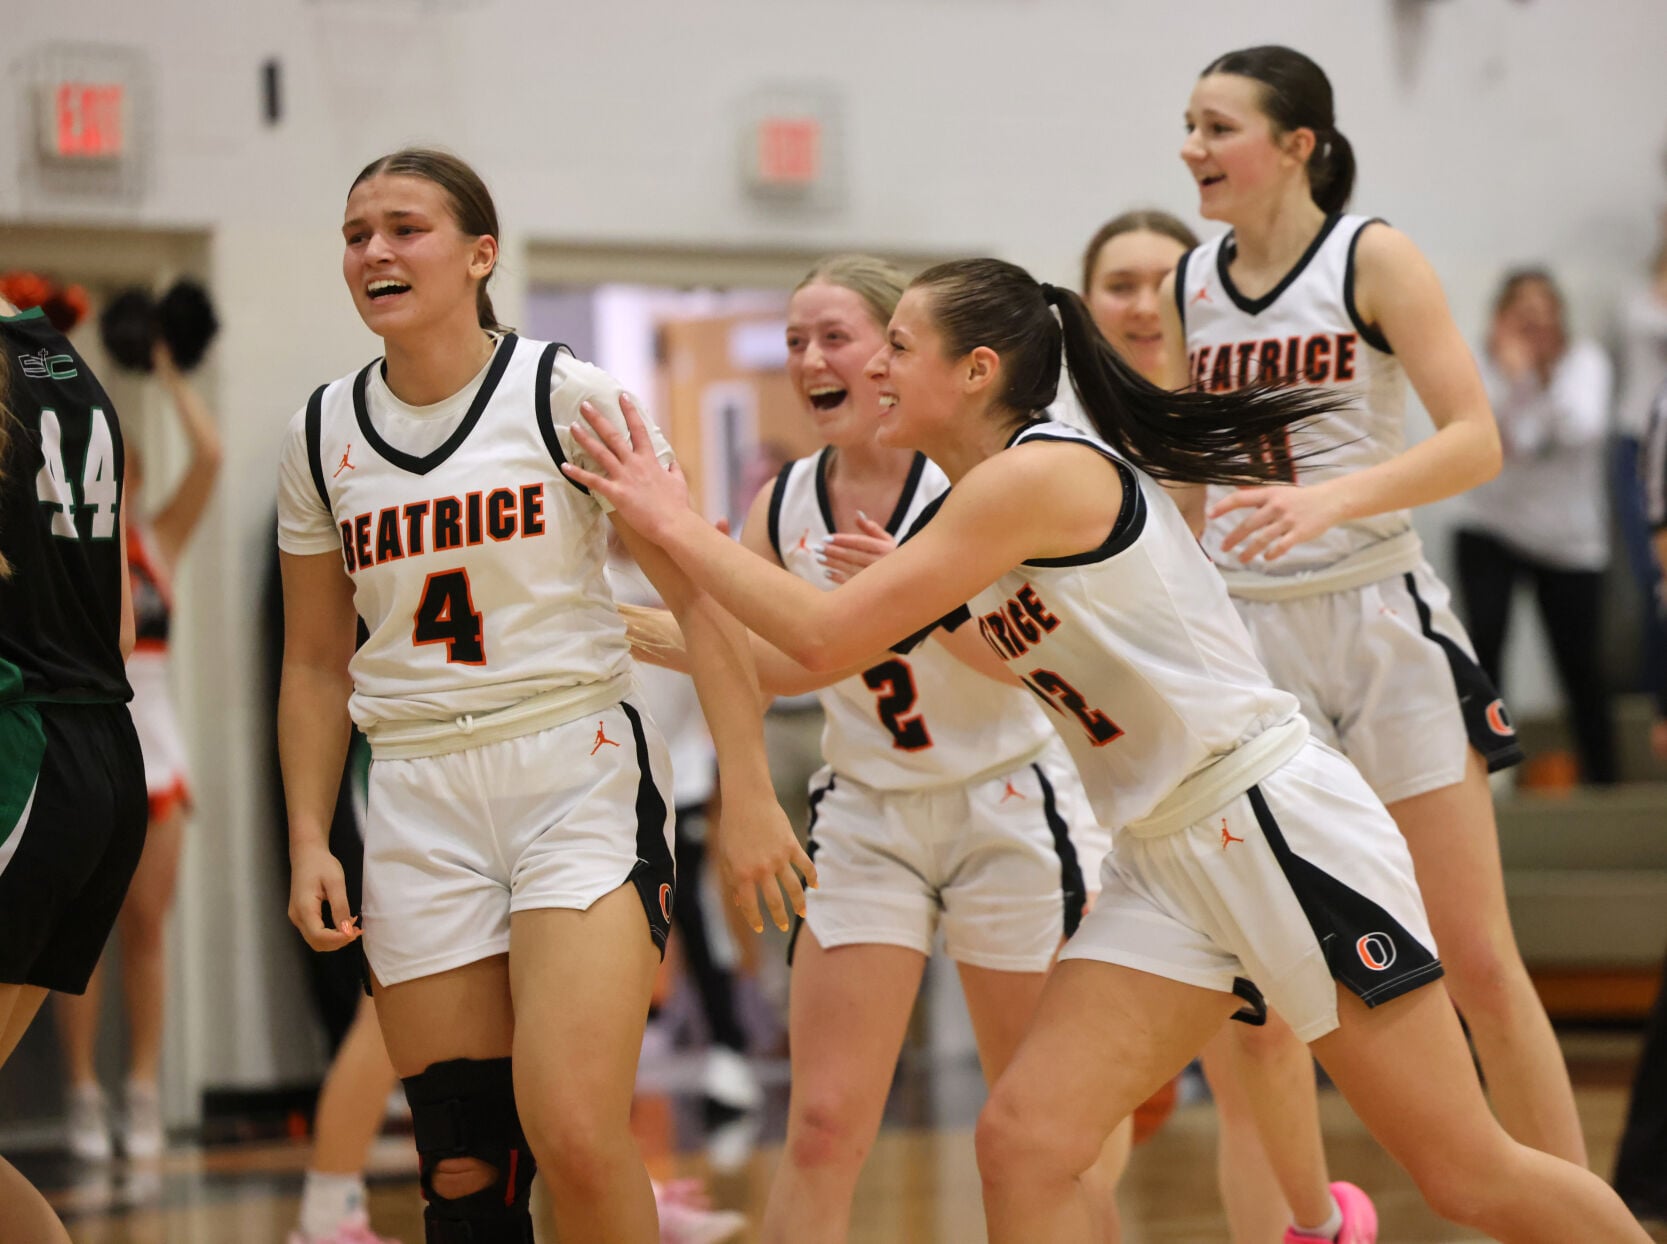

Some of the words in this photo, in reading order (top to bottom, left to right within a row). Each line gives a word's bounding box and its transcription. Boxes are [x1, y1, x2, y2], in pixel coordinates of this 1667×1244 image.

[36, 406, 117, 540] 44
[340, 482, 545, 574] BEATRICE
[412, 566, 487, 666] 4
[862, 657, 934, 752] 2
